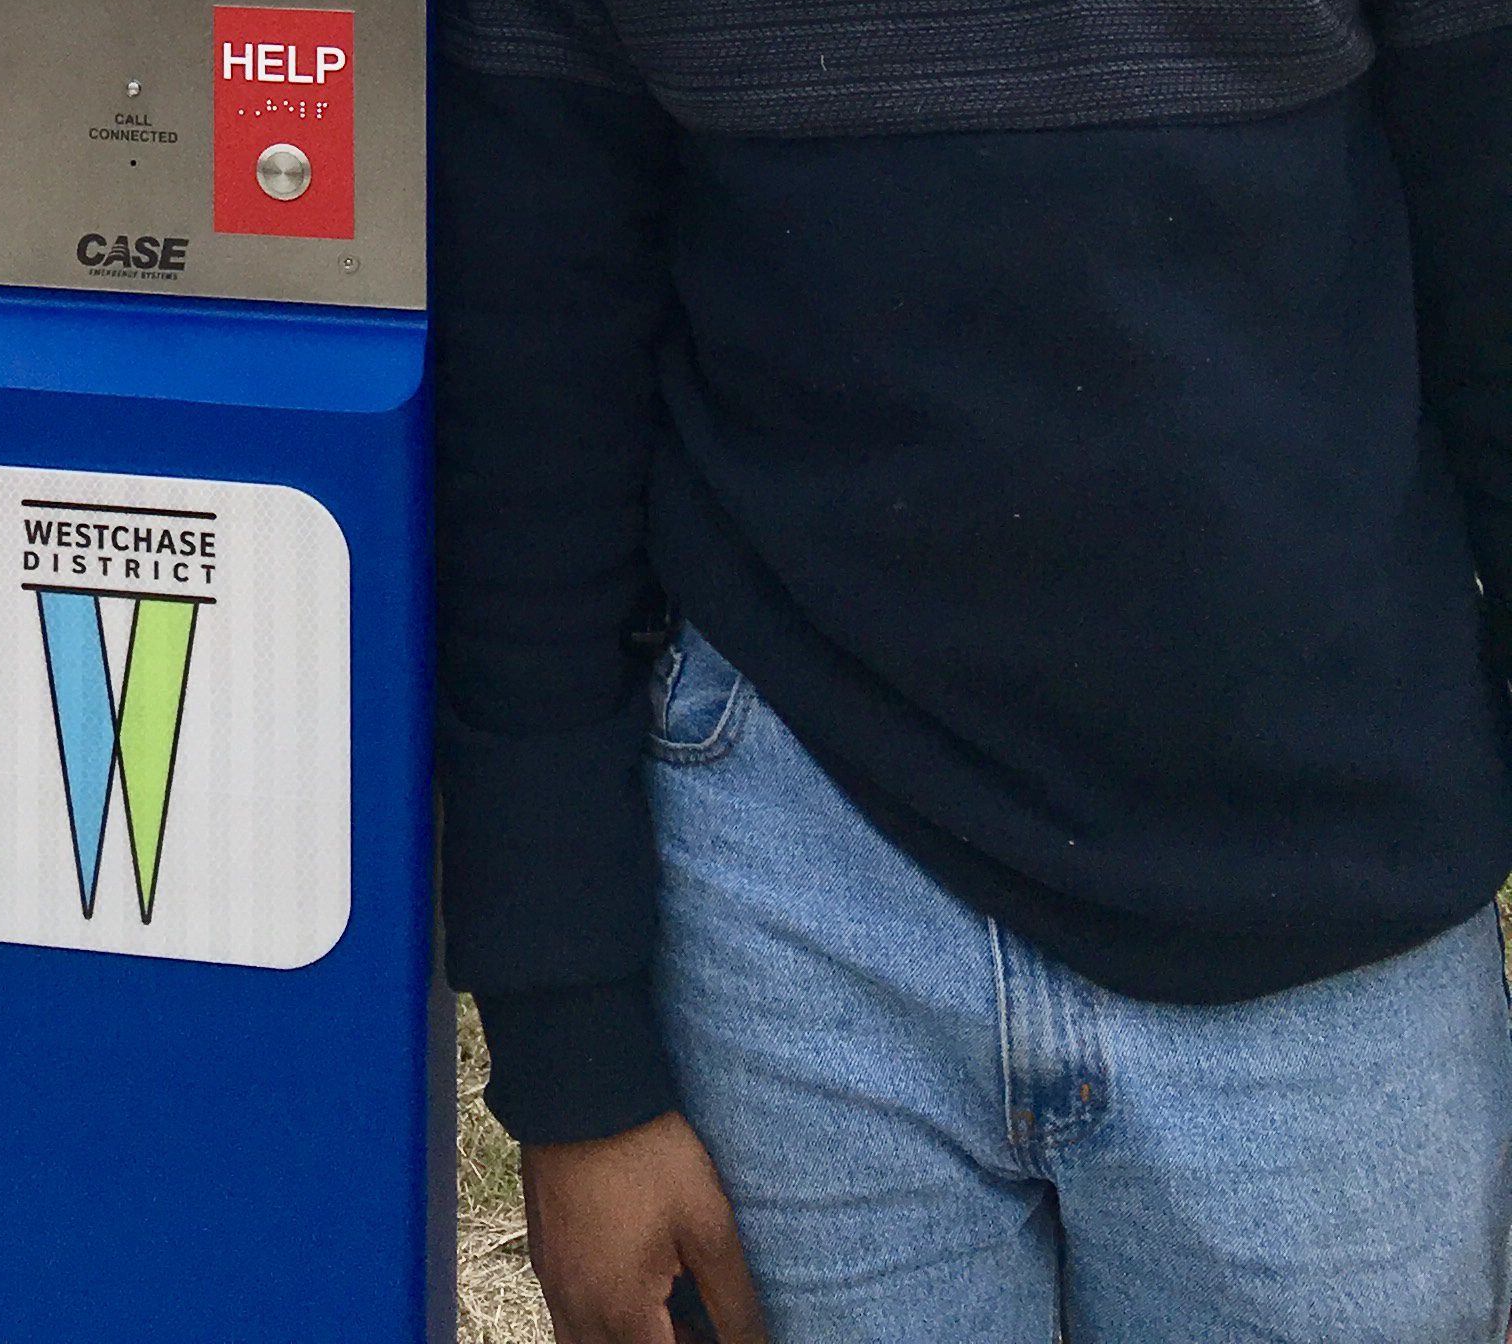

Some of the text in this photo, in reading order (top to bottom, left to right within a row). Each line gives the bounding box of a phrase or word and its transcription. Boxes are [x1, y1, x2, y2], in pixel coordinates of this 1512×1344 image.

[223, 42, 346, 84] HELP
[88, 127, 178, 144] CONNECTED
[114, 112, 152, 126] CALL
[76, 233, 190, 271] CASE
[23, 519, 217, 558] WESTCHASE
[23, 551, 217, 584] DISTRICT
